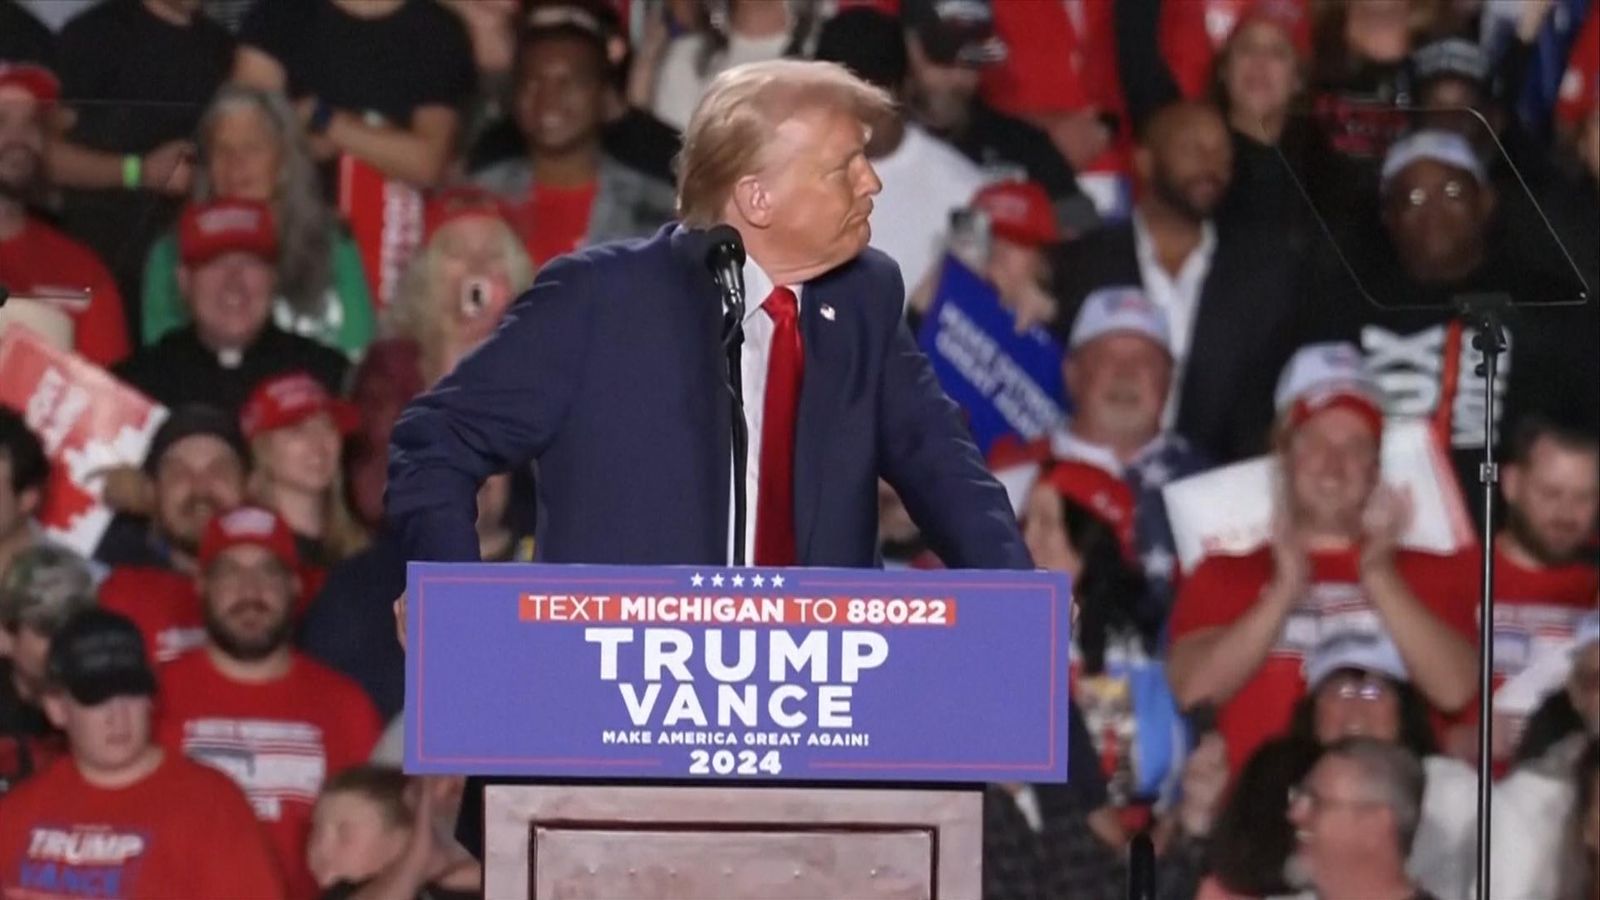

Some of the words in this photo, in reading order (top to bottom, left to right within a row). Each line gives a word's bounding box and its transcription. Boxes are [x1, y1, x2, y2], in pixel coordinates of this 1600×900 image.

[529, 595, 611, 621] TEXT
[620, 596, 785, 623] MICHIGAN
[794, 598, 837, 624] TO
[846, 598, 947, 625] 88022
[585, 628, 889, 683] TRUMP
[618, 683, 853, 728] VANCE
[602, 730, 652, 744] MAKE
[657, 731, 738, 745] AMERICA
[743, 732, 802, 746] GREAT
[807, 733, 869, 747] AGAIN!
[689, 749, 782, 775] 2024
[27, 828, 145, 865] TRUMP
